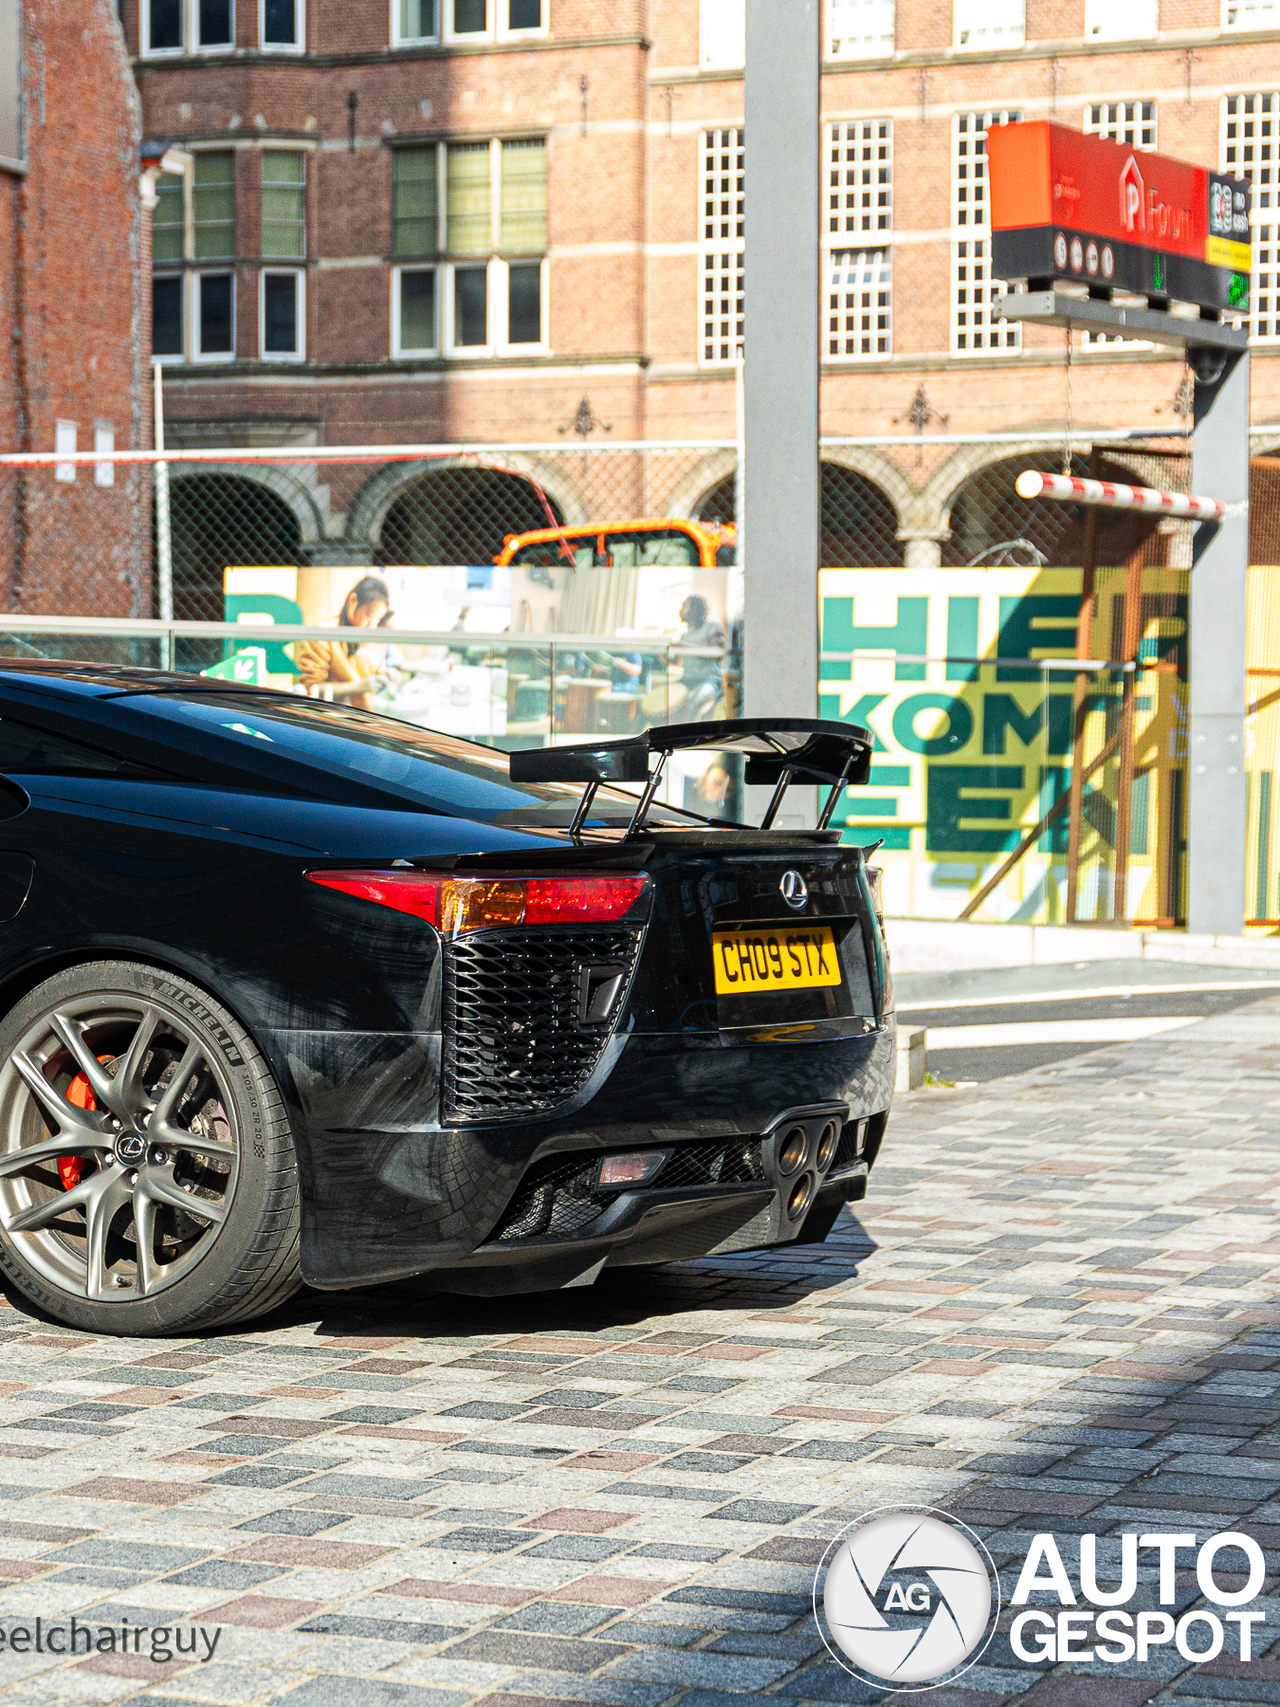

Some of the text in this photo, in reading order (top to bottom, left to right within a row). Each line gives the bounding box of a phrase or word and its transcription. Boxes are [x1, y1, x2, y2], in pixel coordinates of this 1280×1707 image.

[721, 934, 830, 983] CH09 STX
[158, 981, 241, 1062] MICHELIN
[242, 1073, 262, 1140] 305/30 ZR 20
